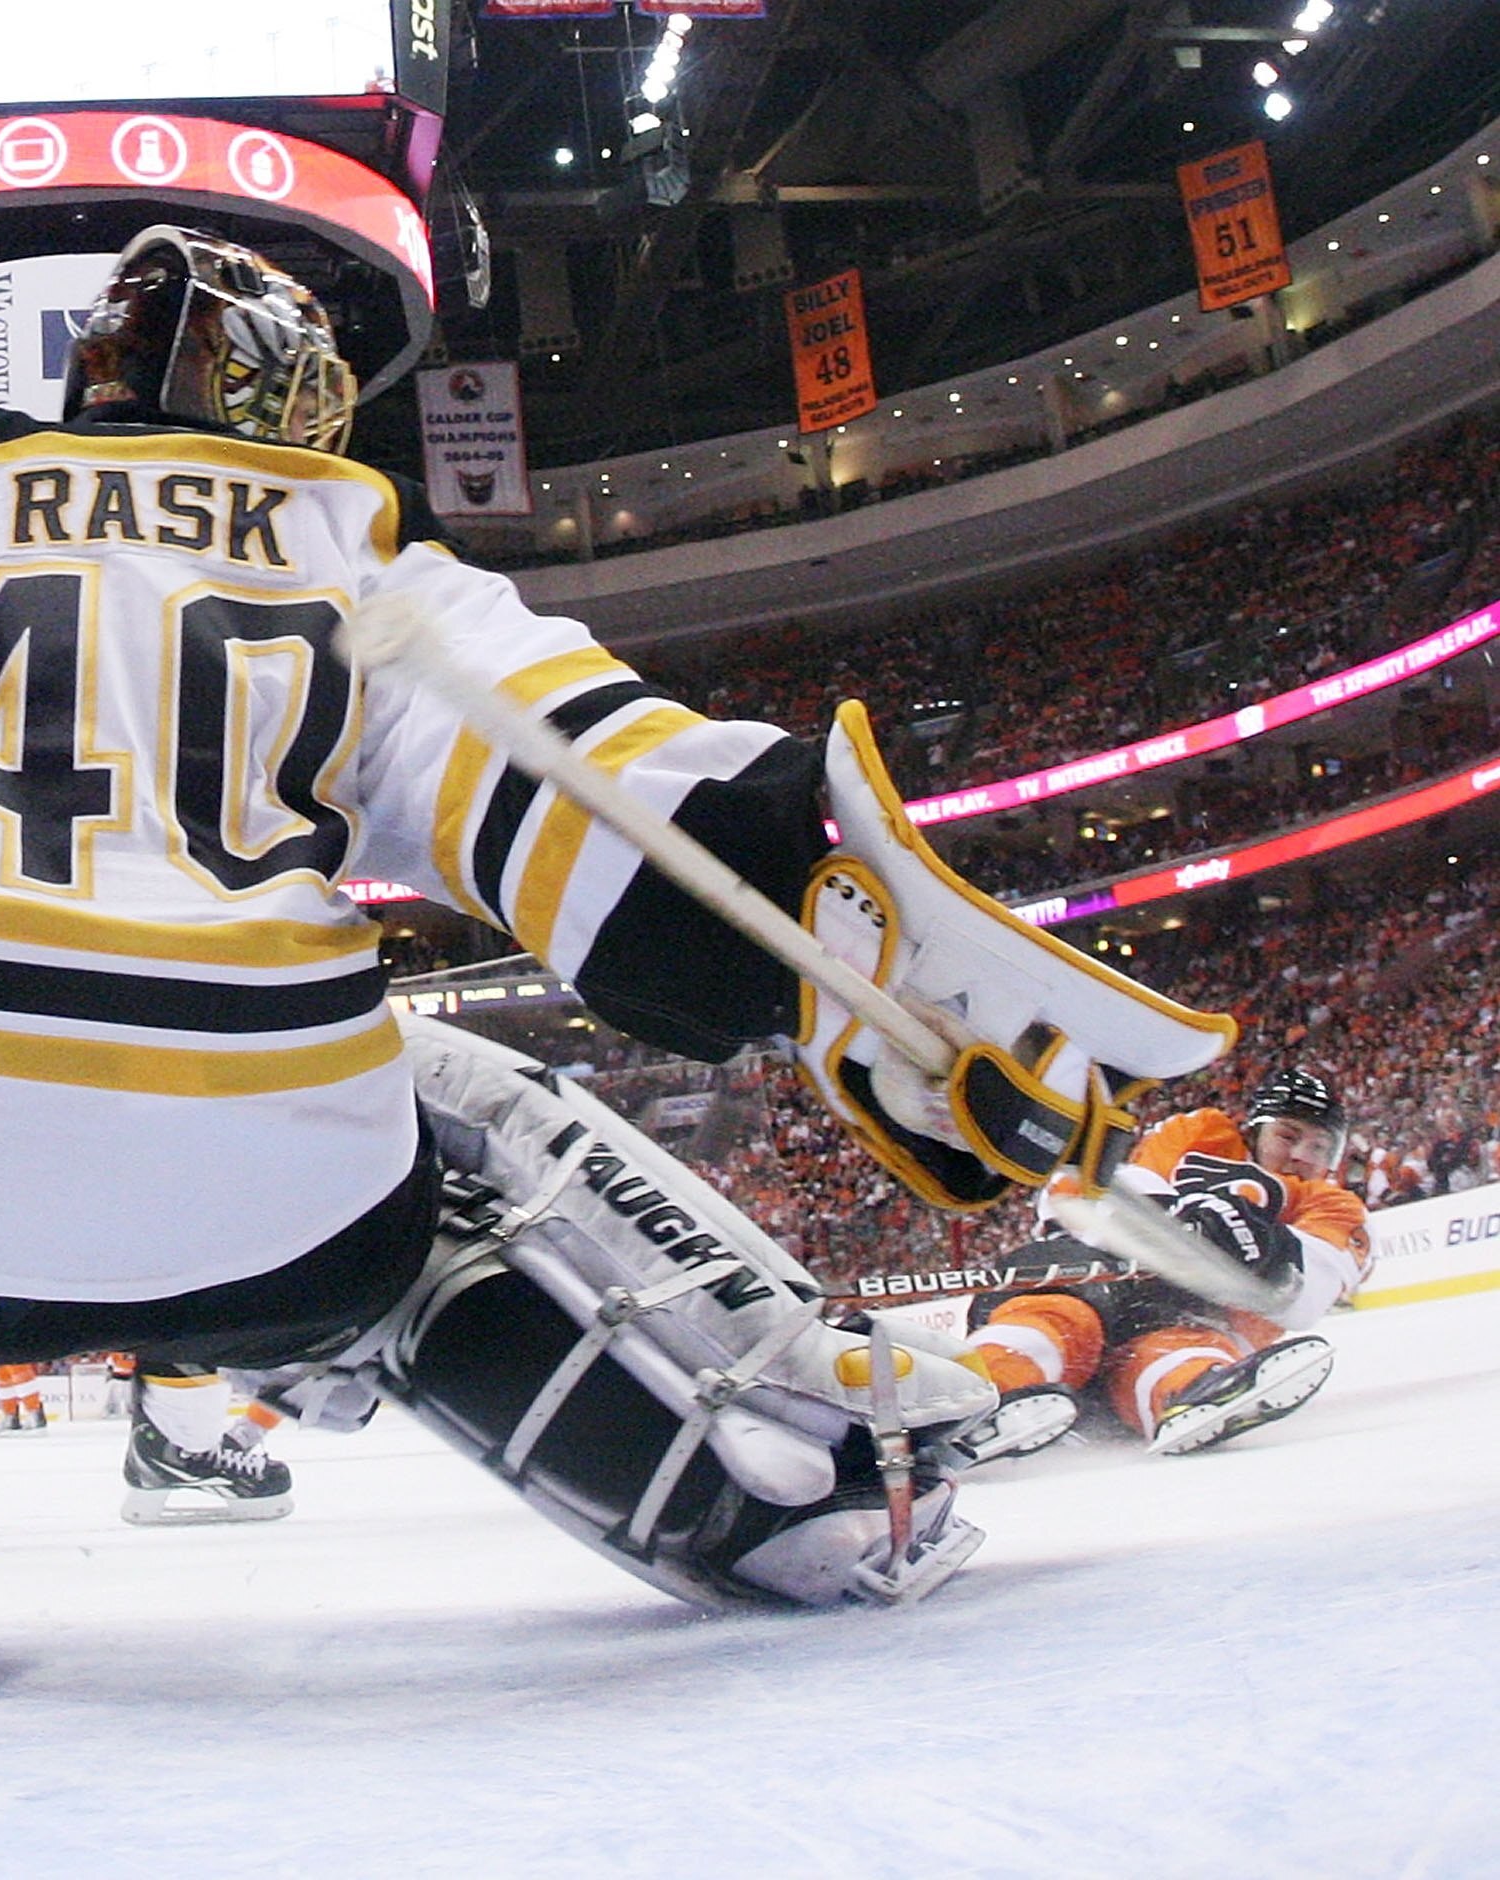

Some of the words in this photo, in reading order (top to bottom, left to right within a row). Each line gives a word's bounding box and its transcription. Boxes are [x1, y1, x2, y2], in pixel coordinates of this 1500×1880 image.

[1215, 219, 1257, 258] 51
[796, 279, 849, 313] BILLY
[802, 313, 855, 346] JOEL
[816, 346, 851, 385] 48
[426, 413, 481, 424] CALDER
[427, 432, 516, 443] CHAMPIONS
[7, 467, 295, 571] RASK
[1310, 681, 1344, 706] THE
[1343, 656, 1405, 694] XFINITY
[1016, 779, 1041, 798] TV
[1046, 754, 1129, 791] INTERNET
[1135, 736, 1187, 764] VOICE
[858, 1268, 990, 1298] BAUER
